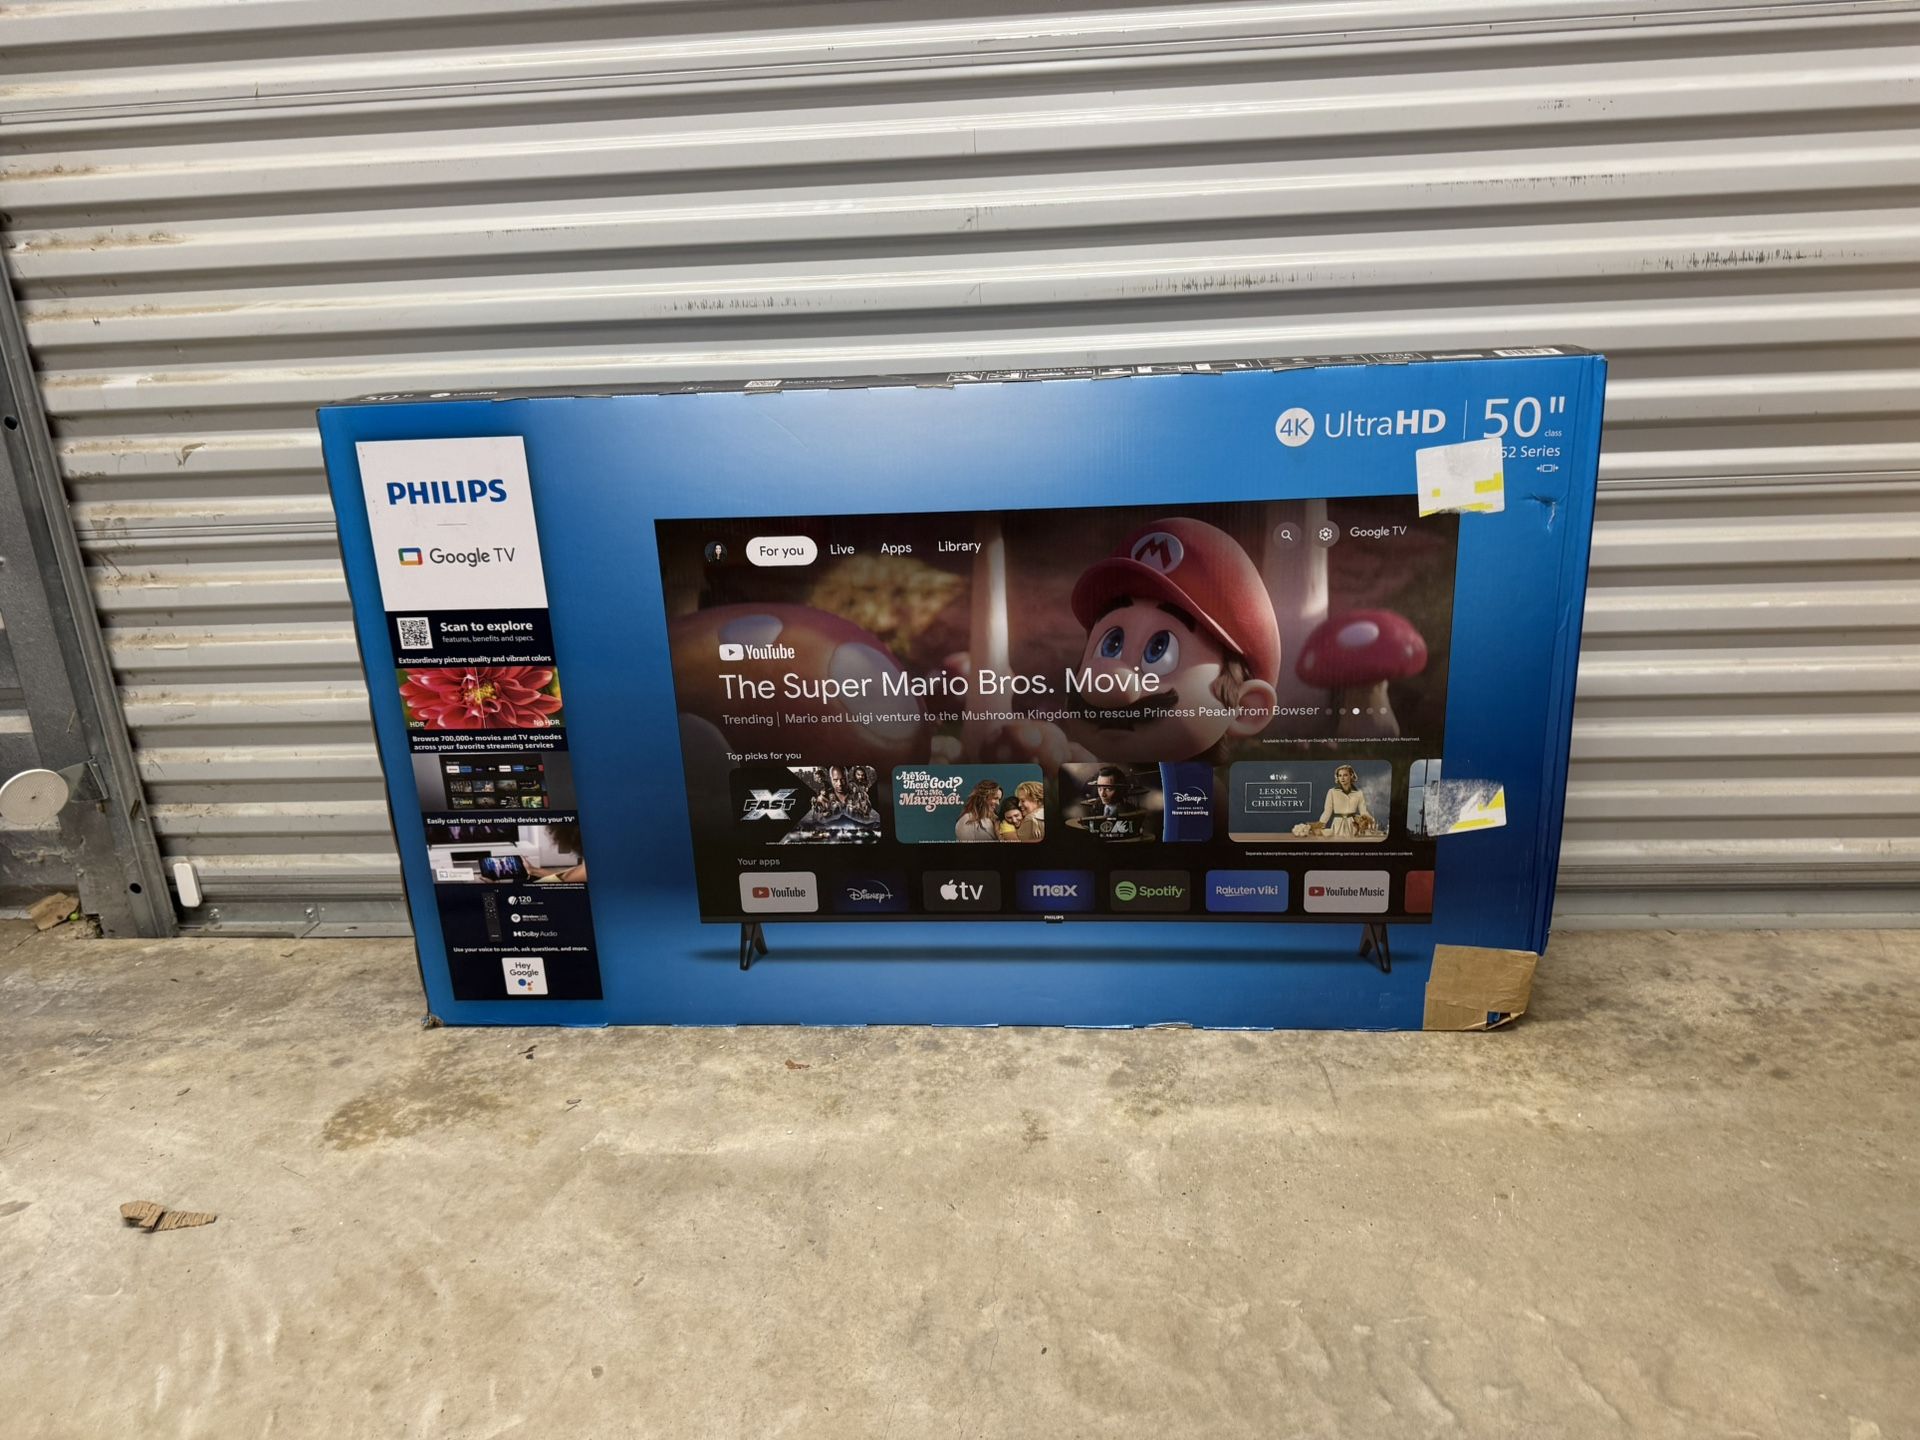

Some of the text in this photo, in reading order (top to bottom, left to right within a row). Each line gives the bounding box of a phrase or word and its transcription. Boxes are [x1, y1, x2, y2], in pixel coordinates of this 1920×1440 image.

[1280, 416, 1310, 436] 4K
[1325, 408, 1446, 438] UltraHD
[1544, 429, 1562, 437] class
[1520, 444, 1560, 458] Series
[386, 478, 507, 505] PHILIPS
[1350, 526, 1407, 539] Google TV
[759, 546, 804, 559] For you
[830, 544, 855, 554] Live
[880, 542, 912, 557] Apps
[938, 541, 982, 554] Library
[430, 548, 515, 568] Google TV
[440, 620, 534, 632] Scan to explore
[515, 635, 534, 643] specs.
[744, 644, 796, 660] YouTube
[398, 656, 443, 665] Extraordinary
[444, 656, 467, 664] picture
[468, 656, 491, 664] quality
[718, 666, 1160, 704] The Super Mario Bros. Movie
[722, 705, 1320, 726] Trending Mario and Luigi venture to the Mushroom Kingdom to rescue Princess Peach from Bowser
[486, 742, 524, 751] streaming
[726, 752, 743, 761] Top
[745, 752, 768, 761] picks
[903, 776, 963, 792] There God?
[1173, 786, 1208, 804] Disney+
[744, 799, 796, 812] FAST
[899, 792, 964, 812] Margaret.
[770, 886, 806, 898] YouTube
[846, 879, 893, 903] Disney+
[959, 882, 984, 900] tv
[1033, 884, 1078, 897] max
[1139, 886, 1184, 898] Spotify
[1216, 885, 1278, 896] Rakuten Viki
[1325, 886, 1385, 897] YouTube Music
[510, 969, 539, 977] Google
